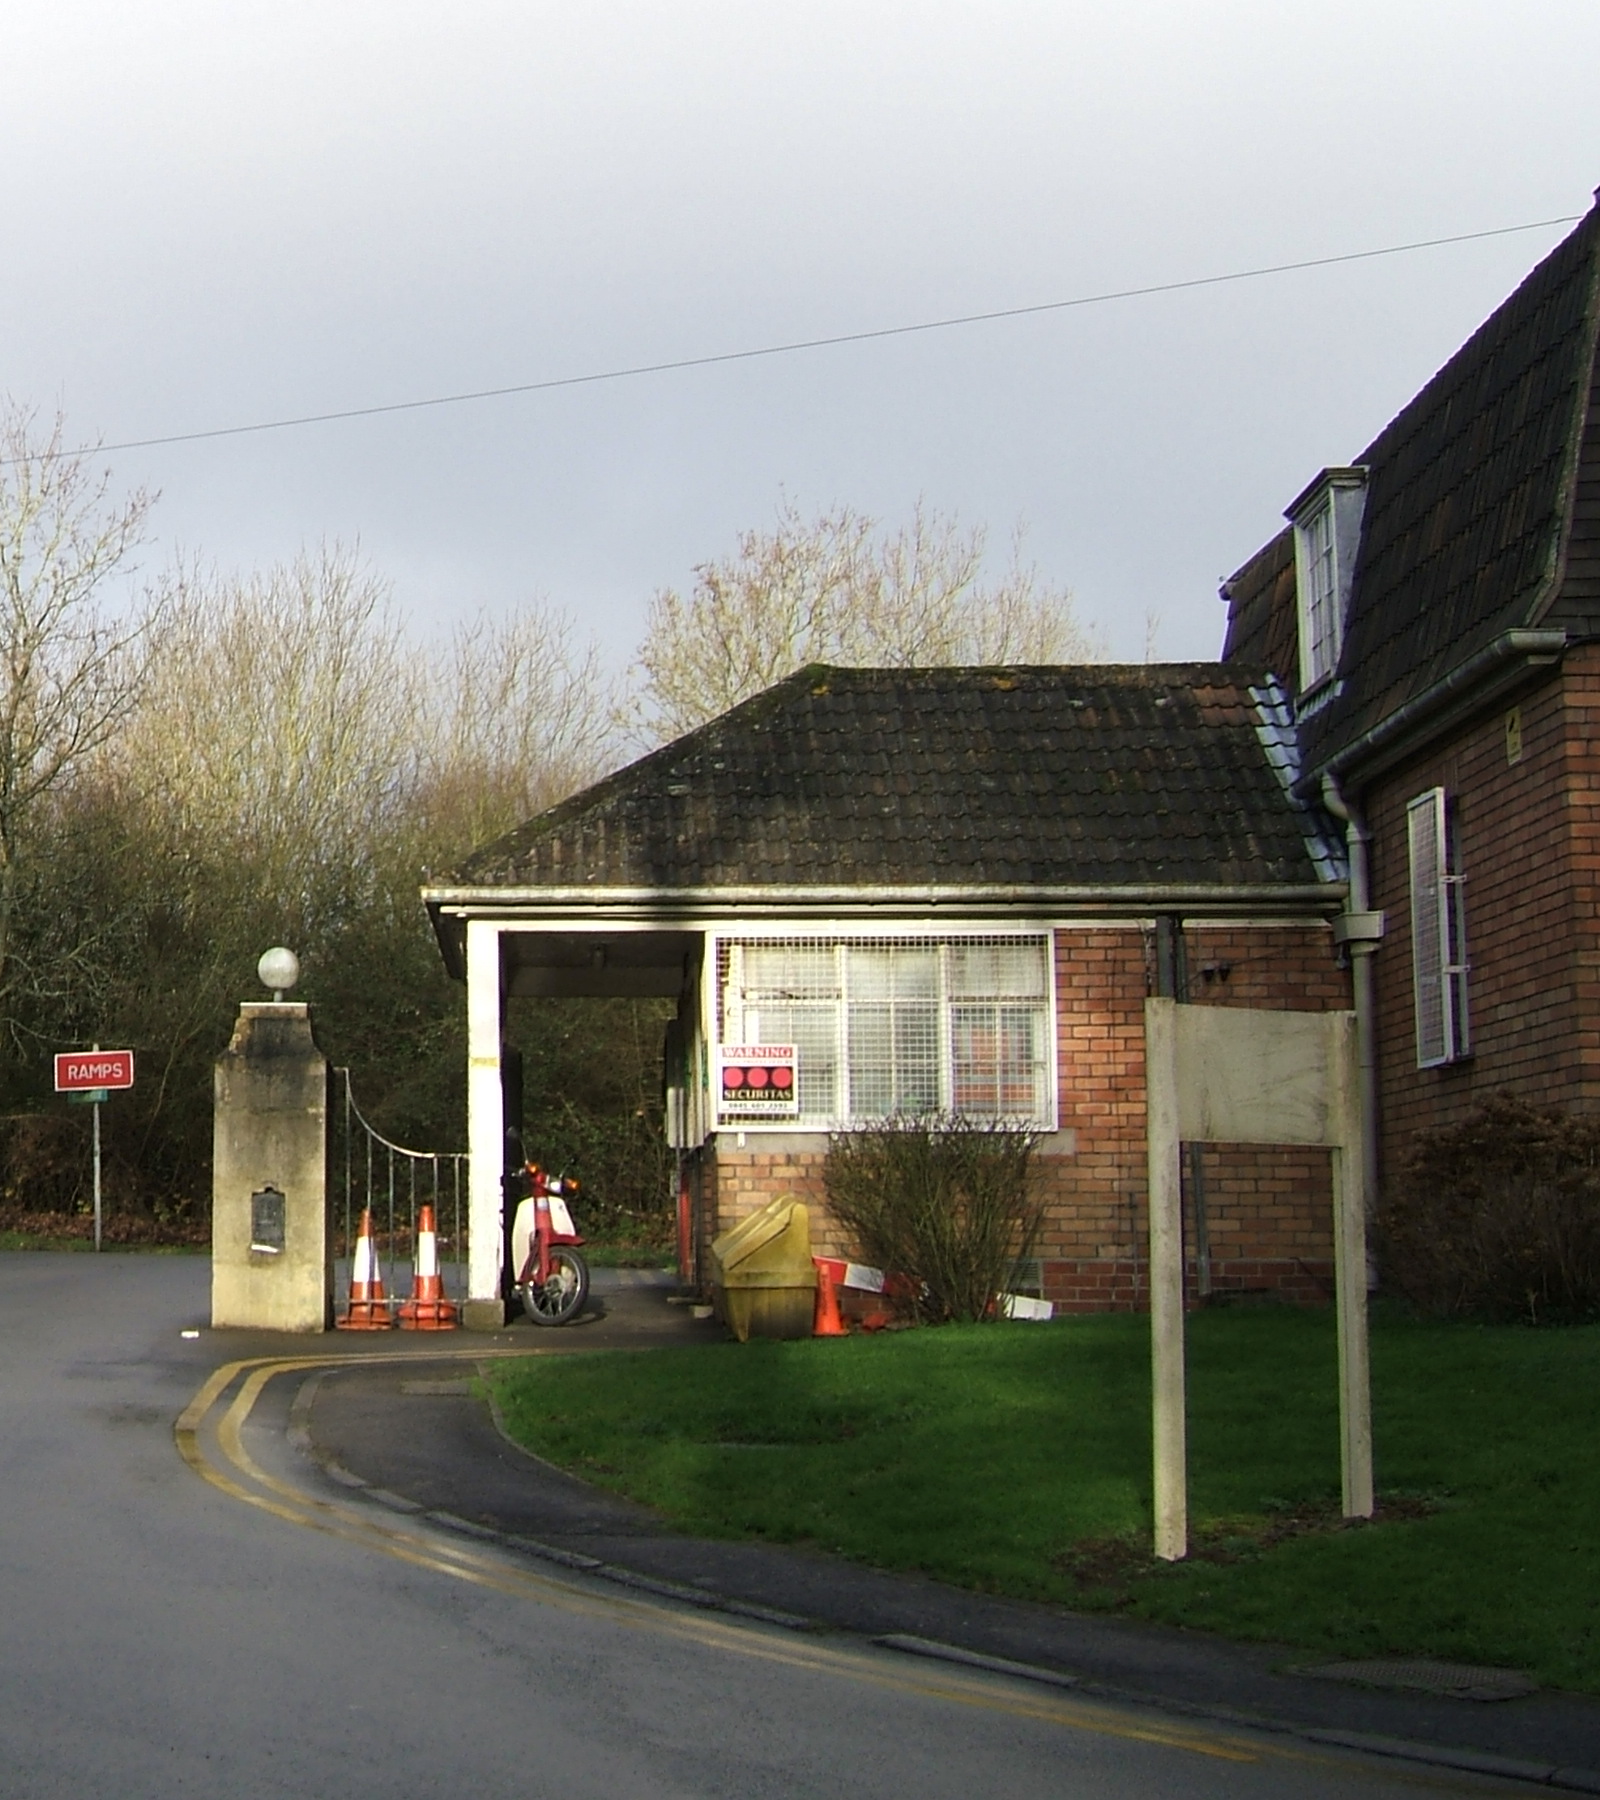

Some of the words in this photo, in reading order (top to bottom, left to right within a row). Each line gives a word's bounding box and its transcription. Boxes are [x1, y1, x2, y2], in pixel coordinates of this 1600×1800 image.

[724, 1047, 792, 1057] WARNING
[67, 1062, 123, 1080] RAMPS
[724, 1089, 791, 1099] SECURITAS
